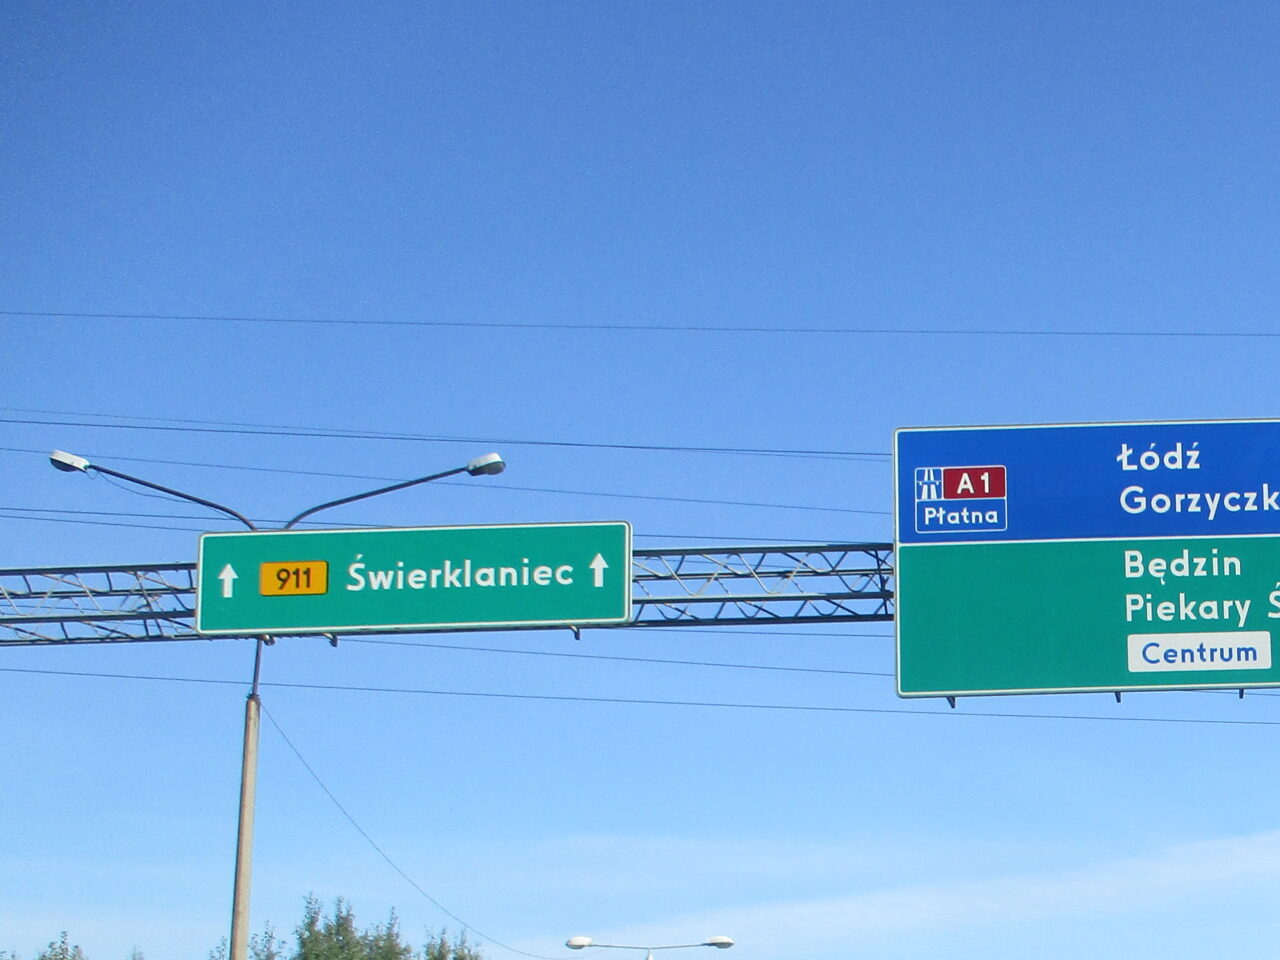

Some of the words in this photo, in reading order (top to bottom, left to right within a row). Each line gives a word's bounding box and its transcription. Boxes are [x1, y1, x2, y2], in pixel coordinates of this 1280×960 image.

[1116, 442, 1201, 472] Łódź
[956, 472, 991, 494] A1
[925, 507, 999, 526] Płatna
[276, 566, 311, 588] 911
[346, 554, 573, 591] Świerklaniec
[1124, 548, 1242, 585] Będzin
[1126, 592, 1252, 629] Piekary
[1142, 641, 1258, 666] Centrum
